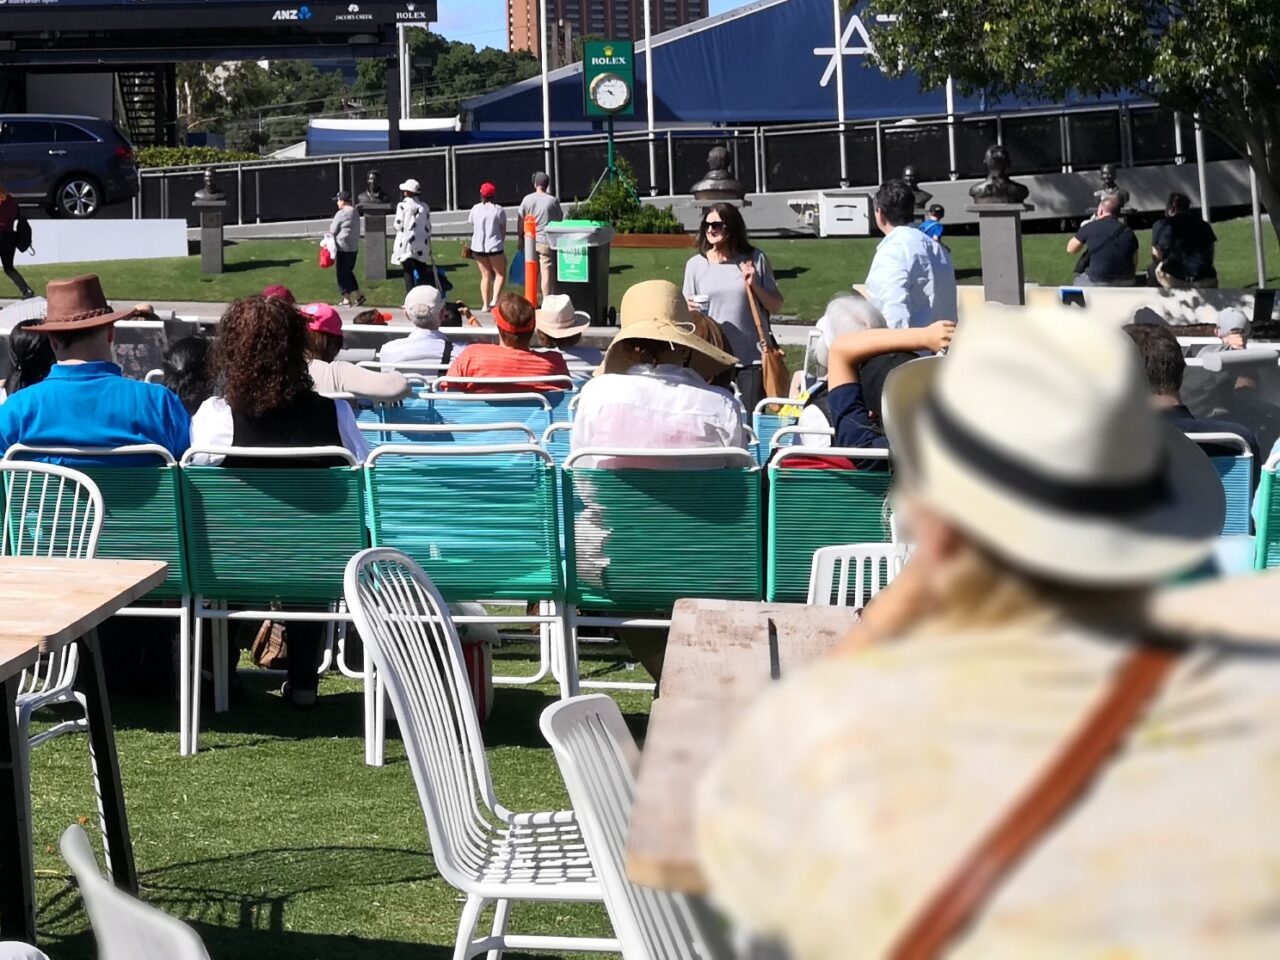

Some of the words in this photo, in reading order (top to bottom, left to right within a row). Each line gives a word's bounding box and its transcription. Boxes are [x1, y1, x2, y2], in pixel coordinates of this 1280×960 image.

[272, 10, 298, 20] ANZ
[396, 11, 426, 19] ROLEX
[592, 57, 626, 65] ROLEX
